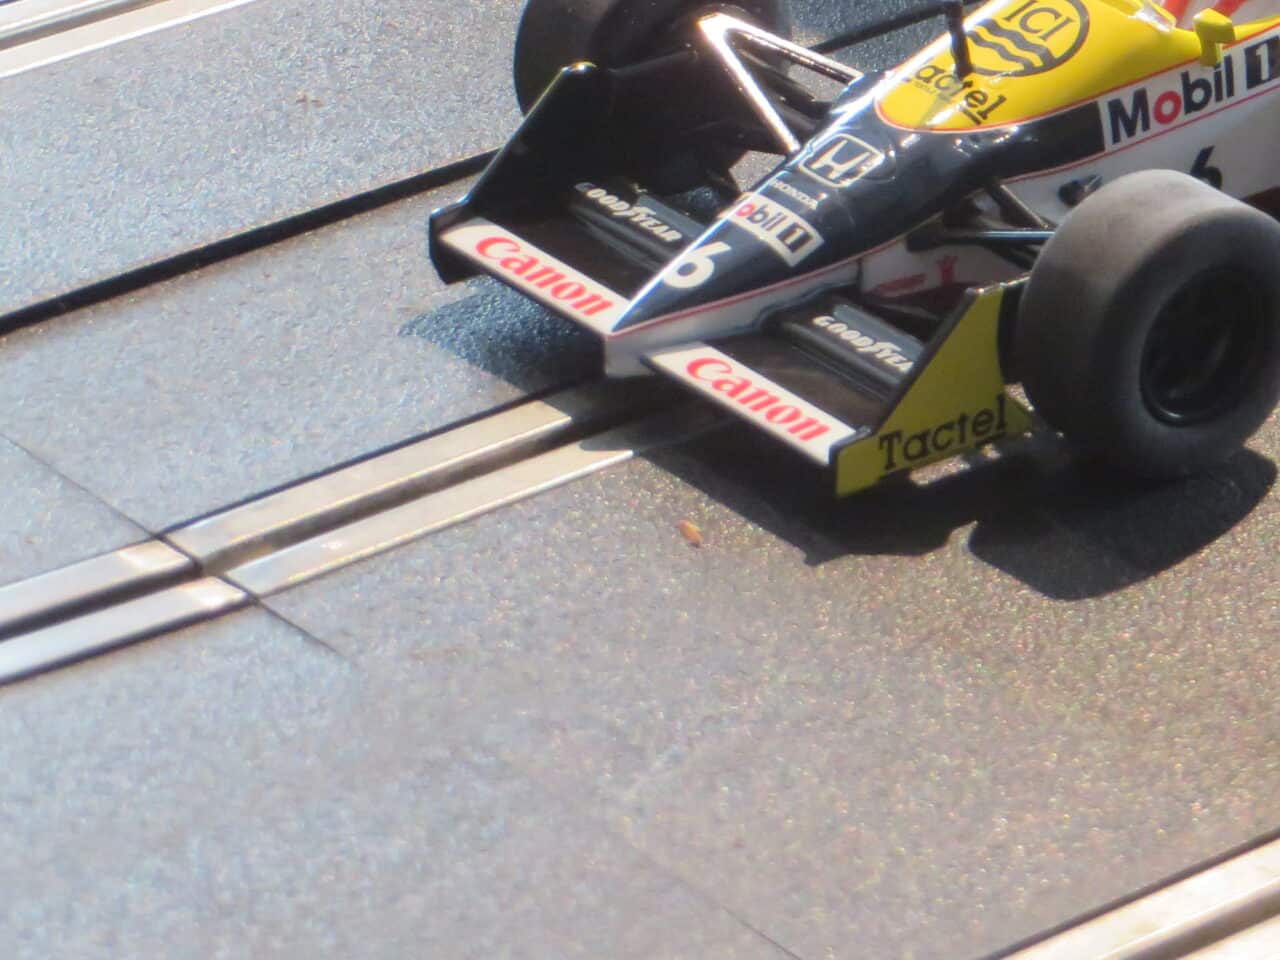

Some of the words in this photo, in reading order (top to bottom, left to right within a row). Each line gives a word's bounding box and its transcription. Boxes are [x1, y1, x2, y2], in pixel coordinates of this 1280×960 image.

[902, 57, 1007, 122] actel
[1107, 54, 1236, 145] Mobil
[574, 181, 683, 242] GOODYEAR
[475, 235, 614, 317] Canon
[663, 241, 732, 289] 6
[812, 315, 914, 373] GOODYEA
[686, 357, 831, 442] Canon
[879, 393, 1009, 471] Tactel
